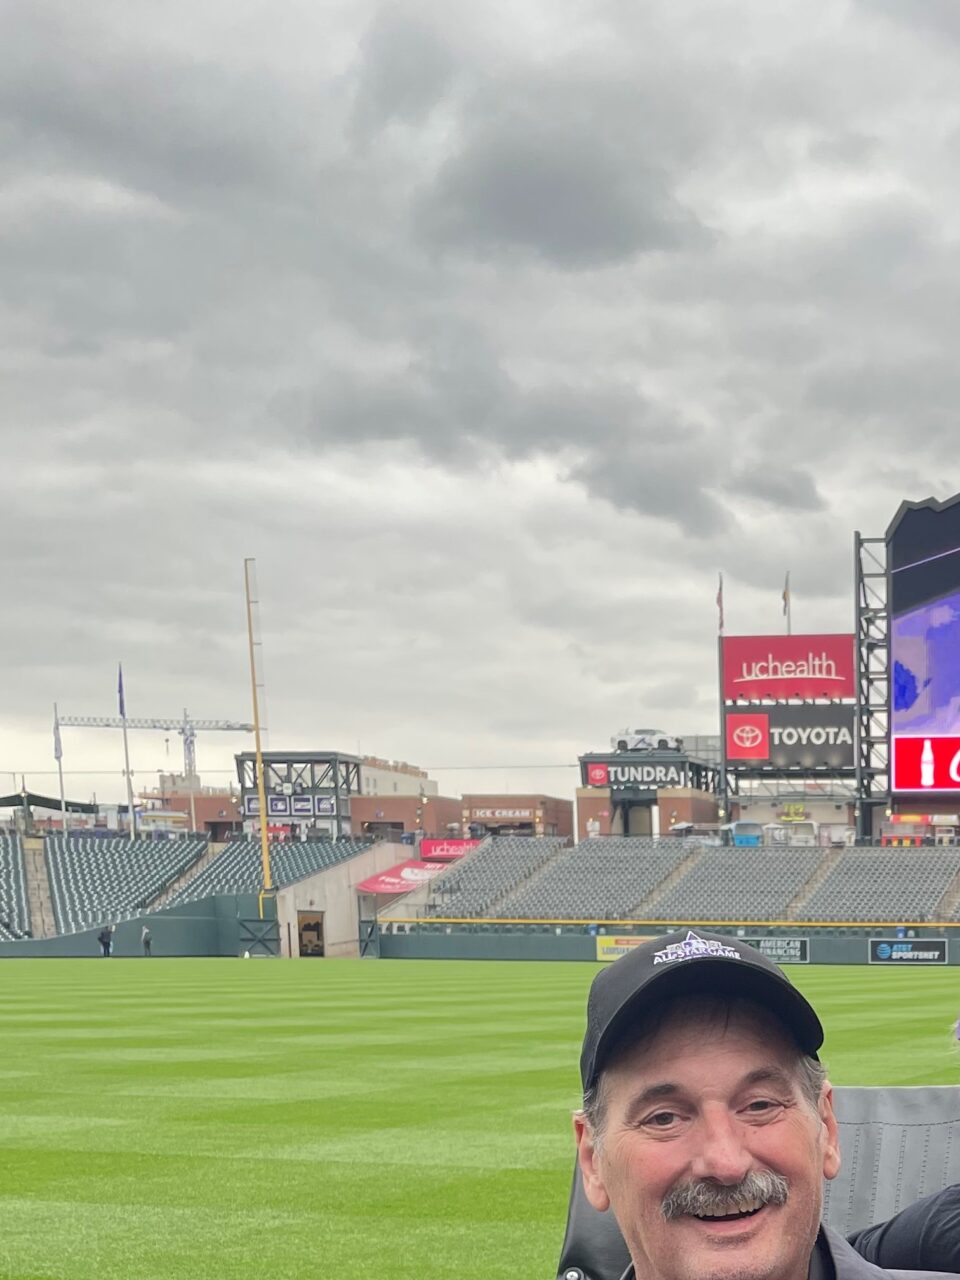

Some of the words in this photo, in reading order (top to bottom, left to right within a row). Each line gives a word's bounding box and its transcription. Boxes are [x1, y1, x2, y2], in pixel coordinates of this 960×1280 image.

[742, 651, 837, 680] uchealth
[769, 727, 853, 745] TOYOTA
[607, 766, 680, 783] TUNDRA
[476, 809, 494, 818] ICE
[495, 809, 531, 818] CREAM
[431, 841, 478, 857] uchealt
[759, 947, 801, 957] FINANCING
[760, 940, 801, 948] AMERICAN
